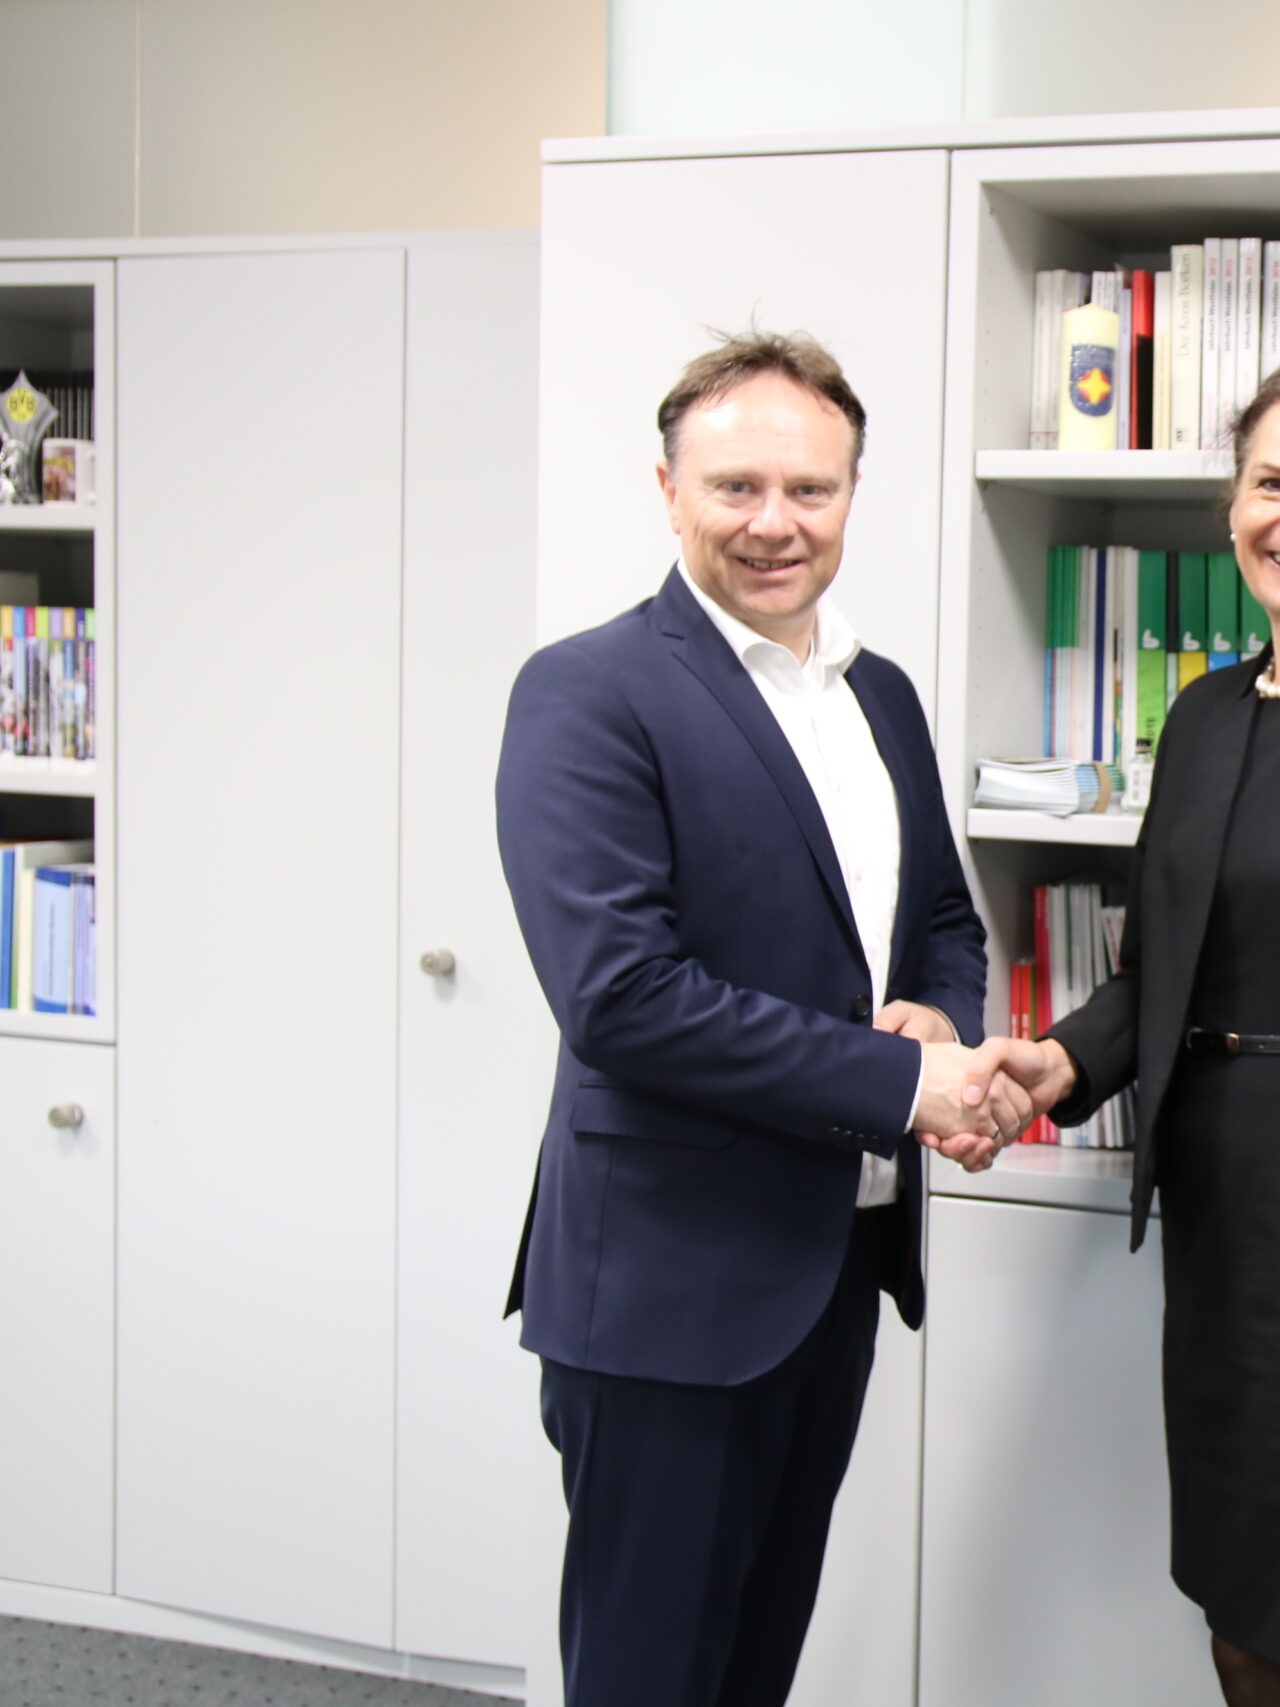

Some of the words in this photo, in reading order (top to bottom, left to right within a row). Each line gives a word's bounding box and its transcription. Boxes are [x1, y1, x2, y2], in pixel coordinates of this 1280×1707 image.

[1178, 253, 1191, 295] Borken
[1178, 300, 1190, 331] Kreis
[1178, 335, 1190, 357] Der
